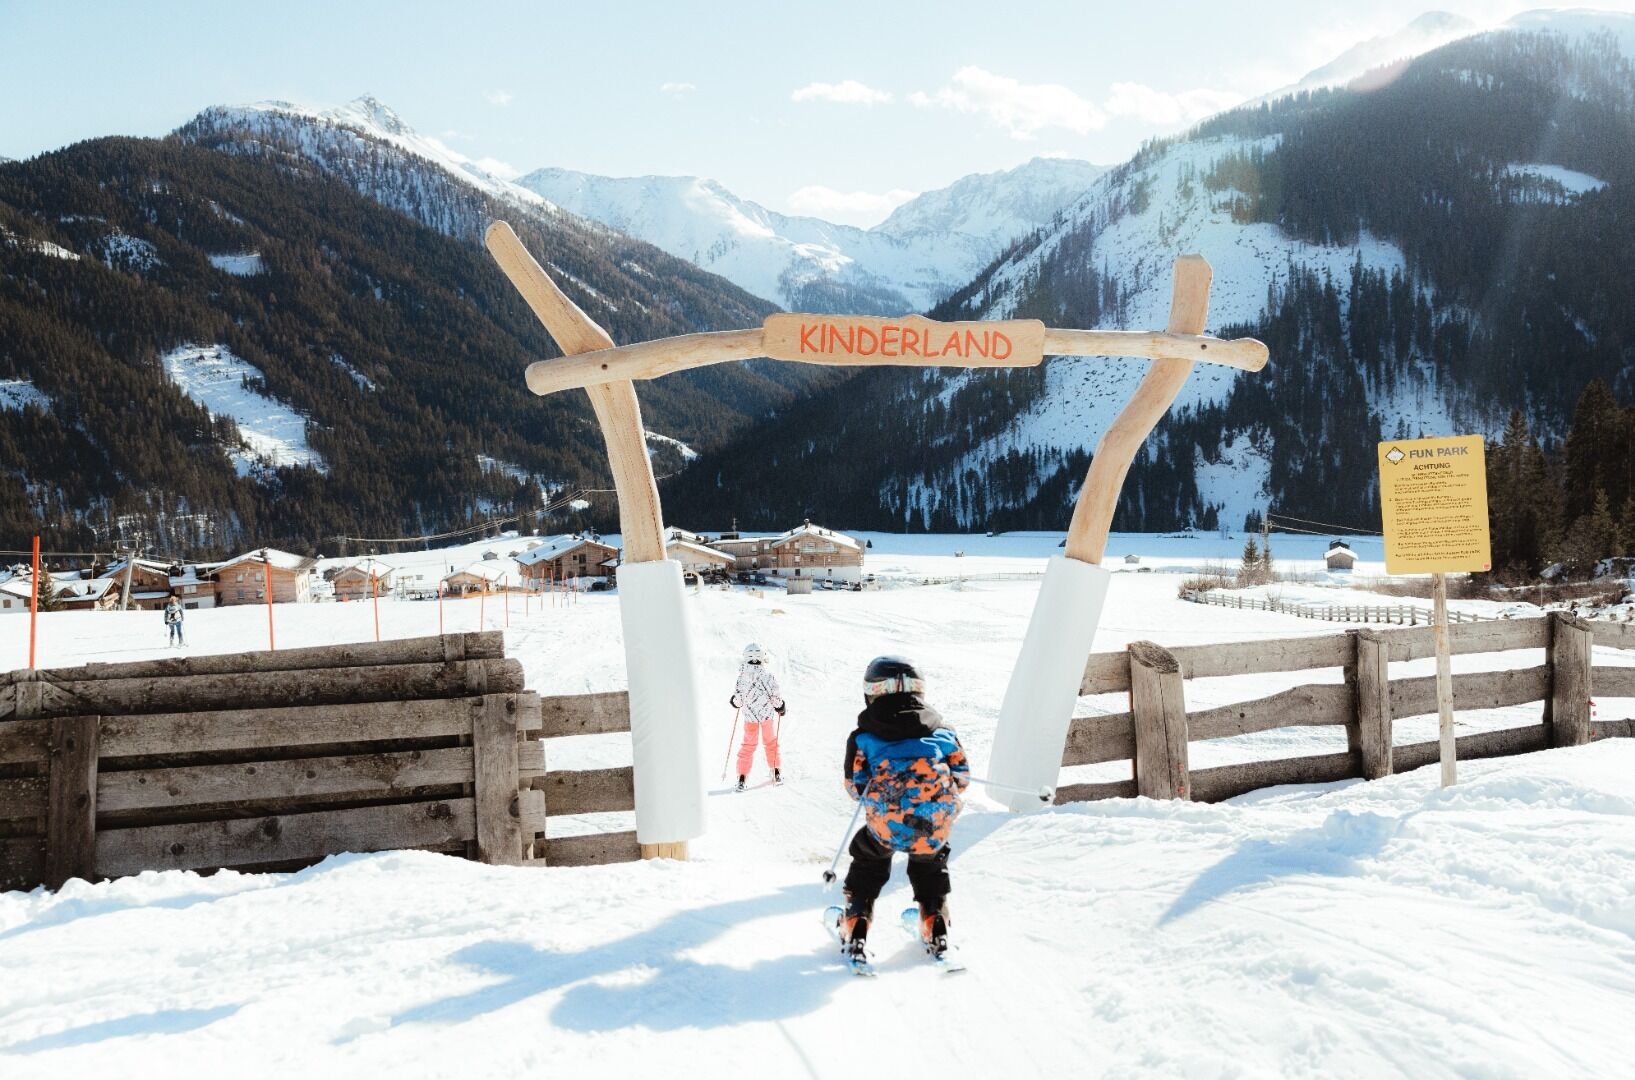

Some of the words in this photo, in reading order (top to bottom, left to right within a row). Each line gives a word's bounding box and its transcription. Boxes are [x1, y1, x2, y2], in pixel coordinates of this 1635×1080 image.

[800, 323, 1013, 360] KINDERLAND
[1409, 448, 1434, 459] FUN
[1436, 446, 1469, 457] PARK
[1413, 462, 1451, 471] ACHTUNG
